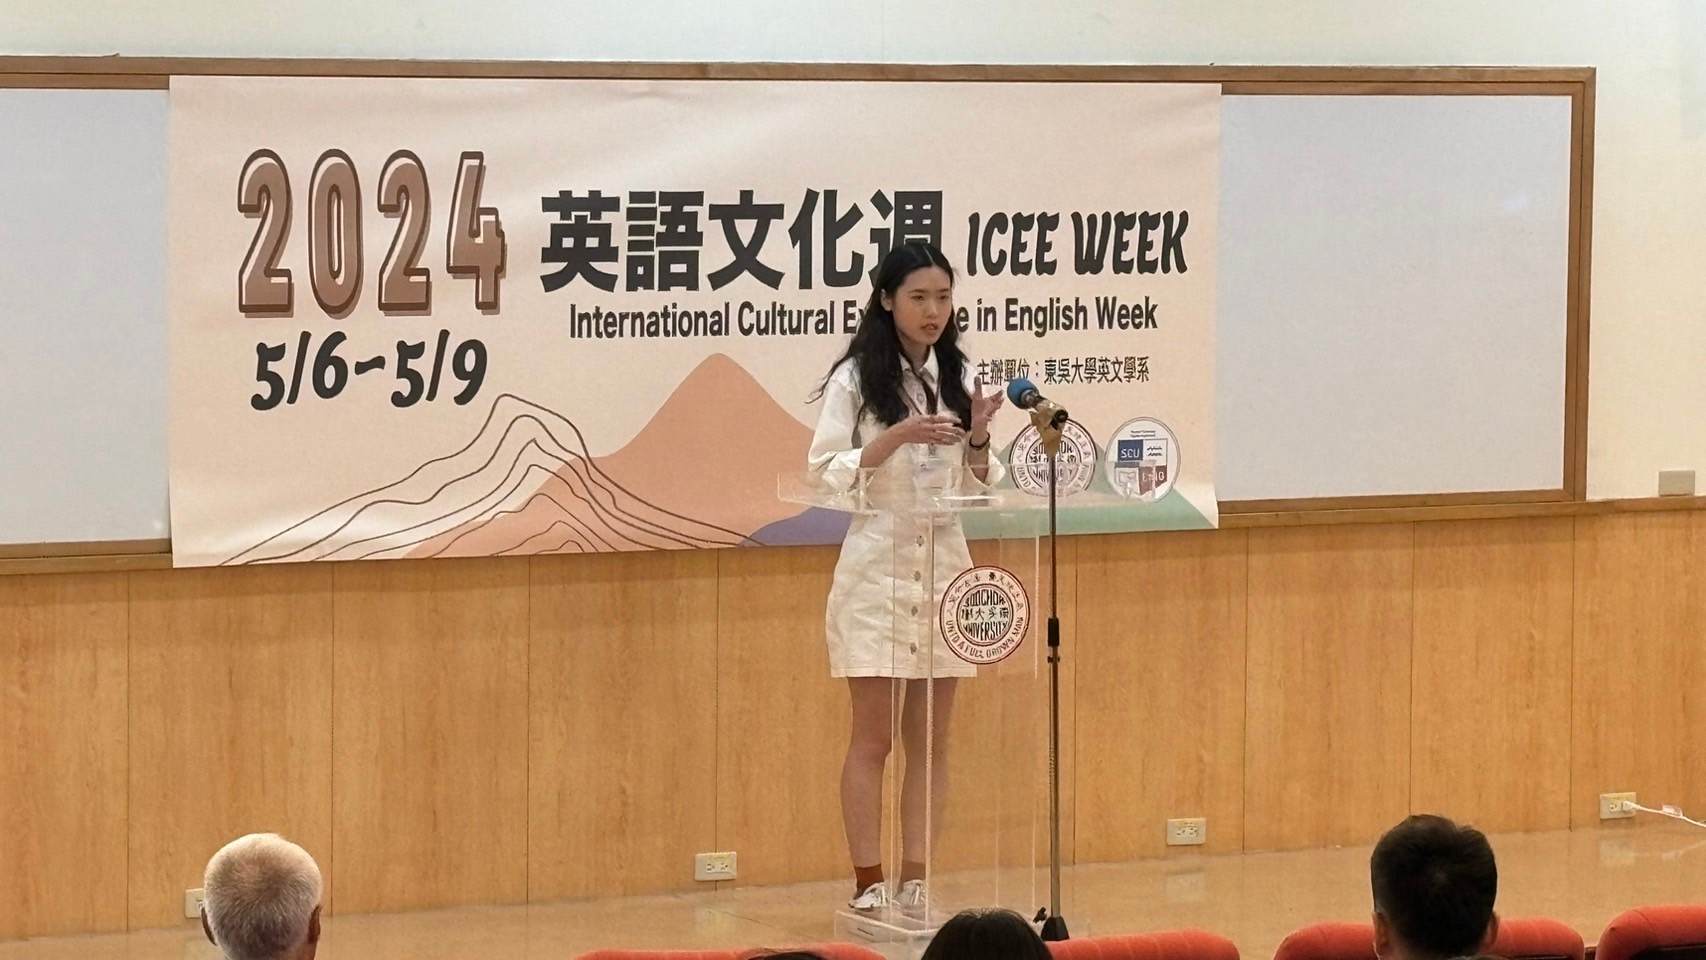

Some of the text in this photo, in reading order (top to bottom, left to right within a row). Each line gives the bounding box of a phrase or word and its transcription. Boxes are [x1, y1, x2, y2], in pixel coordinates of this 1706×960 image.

[237, 148, 507, 319] 2024
[540, 187, 943, 293] 英語文化週
[966, 209, 1189, 277] ICEE WEEK
[570, 302, 730, 338] International
[738, 300, 836, 337] Cultural
[976, 298, 997, 332] in
[1005, 296, 1089, 338] English
[1095, 296, 1159, 331] Week
[1120, 447, 1140, 459] SCU
